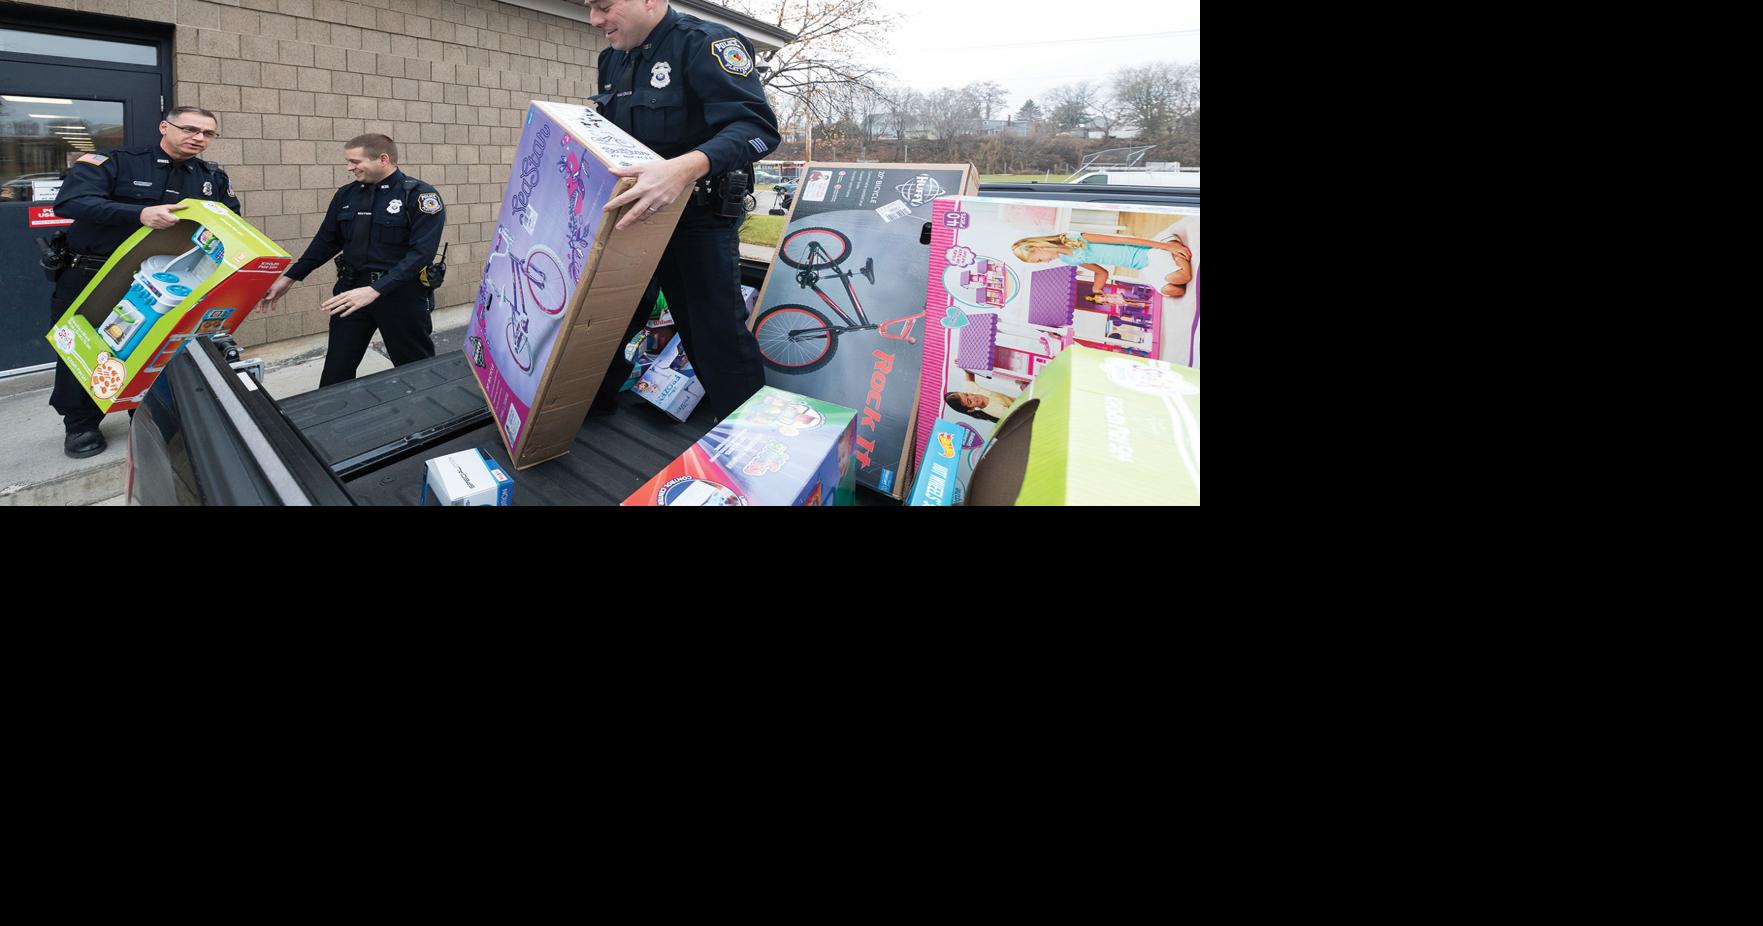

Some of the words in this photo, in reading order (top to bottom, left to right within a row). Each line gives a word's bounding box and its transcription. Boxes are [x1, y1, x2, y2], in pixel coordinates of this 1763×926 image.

[871, 180, 883, 204] BICYCLE
[911, 175, 929, 206] HUFFY
[664, 475, 692, 488] CONTROL
